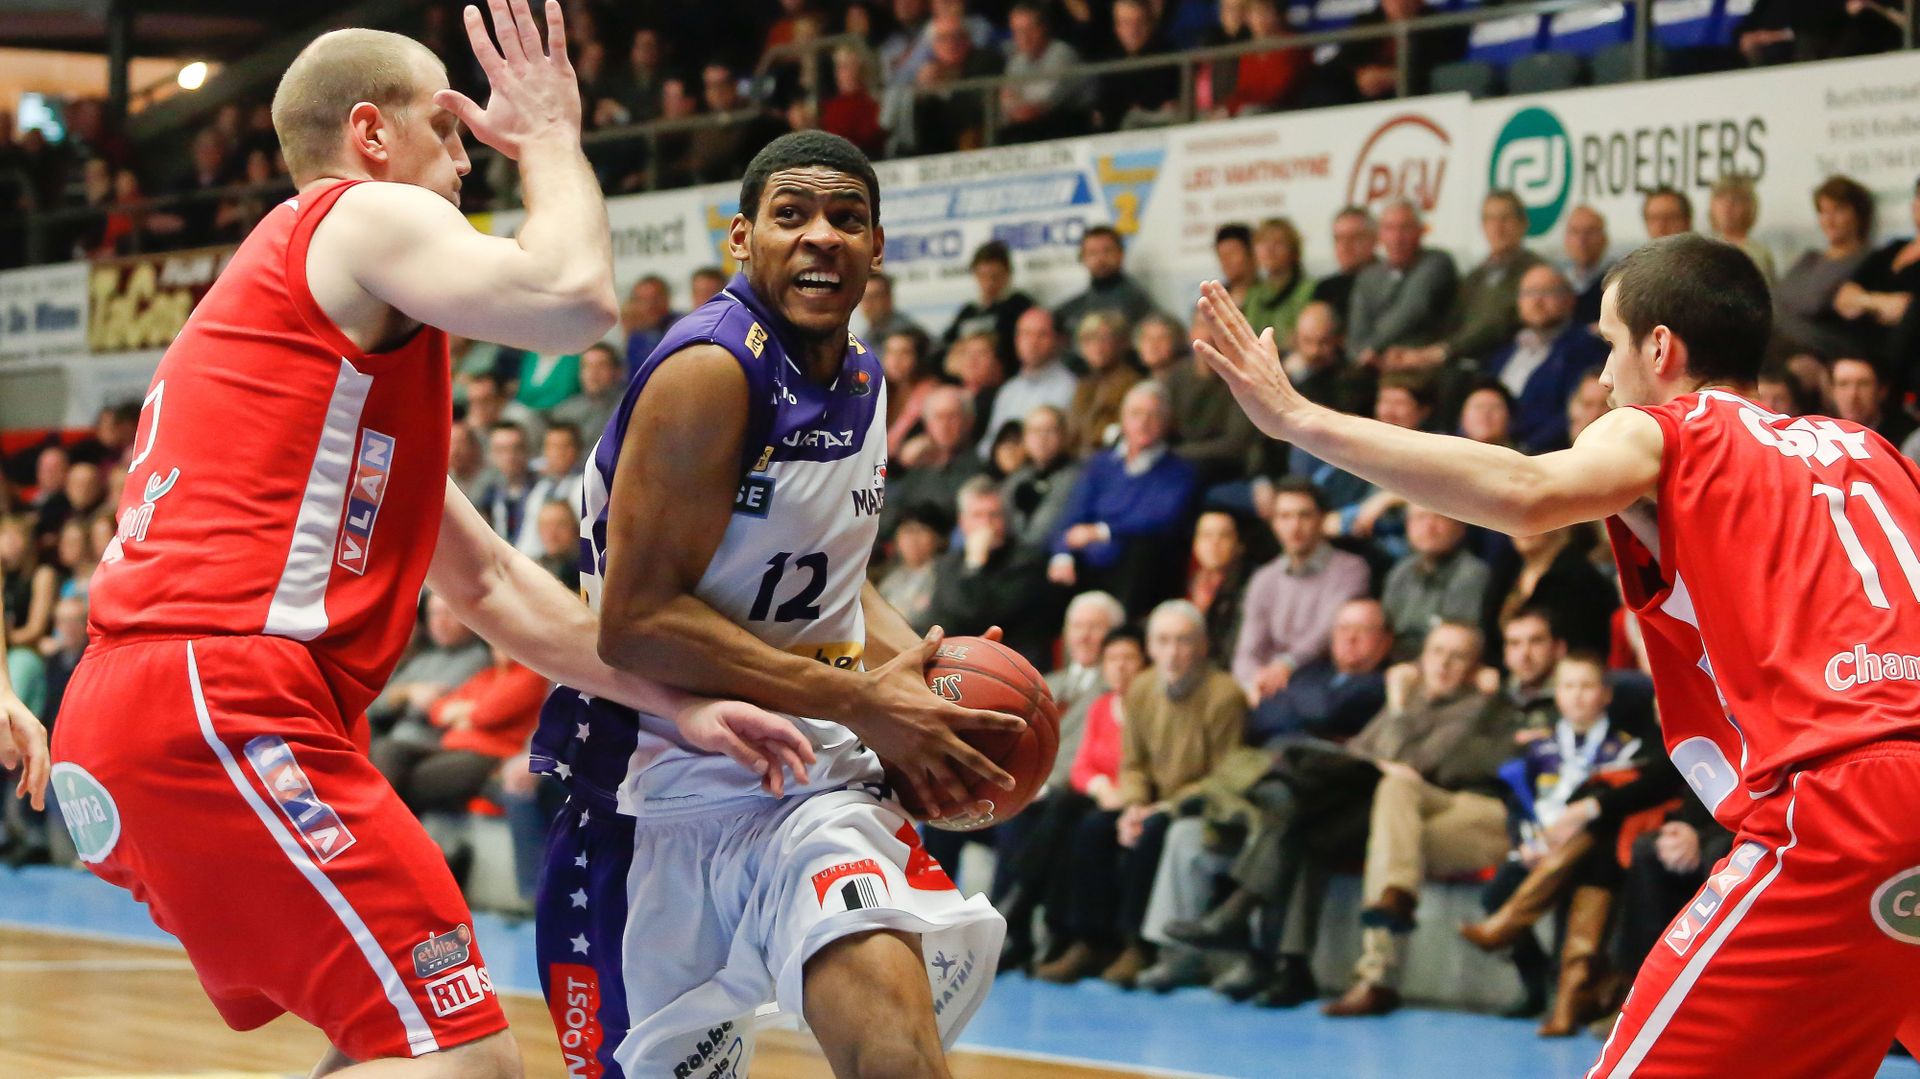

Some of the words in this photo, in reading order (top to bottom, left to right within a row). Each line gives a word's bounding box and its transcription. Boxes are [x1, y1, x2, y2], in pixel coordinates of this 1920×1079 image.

[1582, 114, 1768, 202] ROEGIERS
[343, 438, 389, 561] VLAN
[749, 552, 828, 623] 12
[1812, 481, 1920, 609] 11
[1671, 842, 1762, 941] VLAN
[432, 974, 480, 1012] RTL
[562, 976, 588, 1049] OOST
